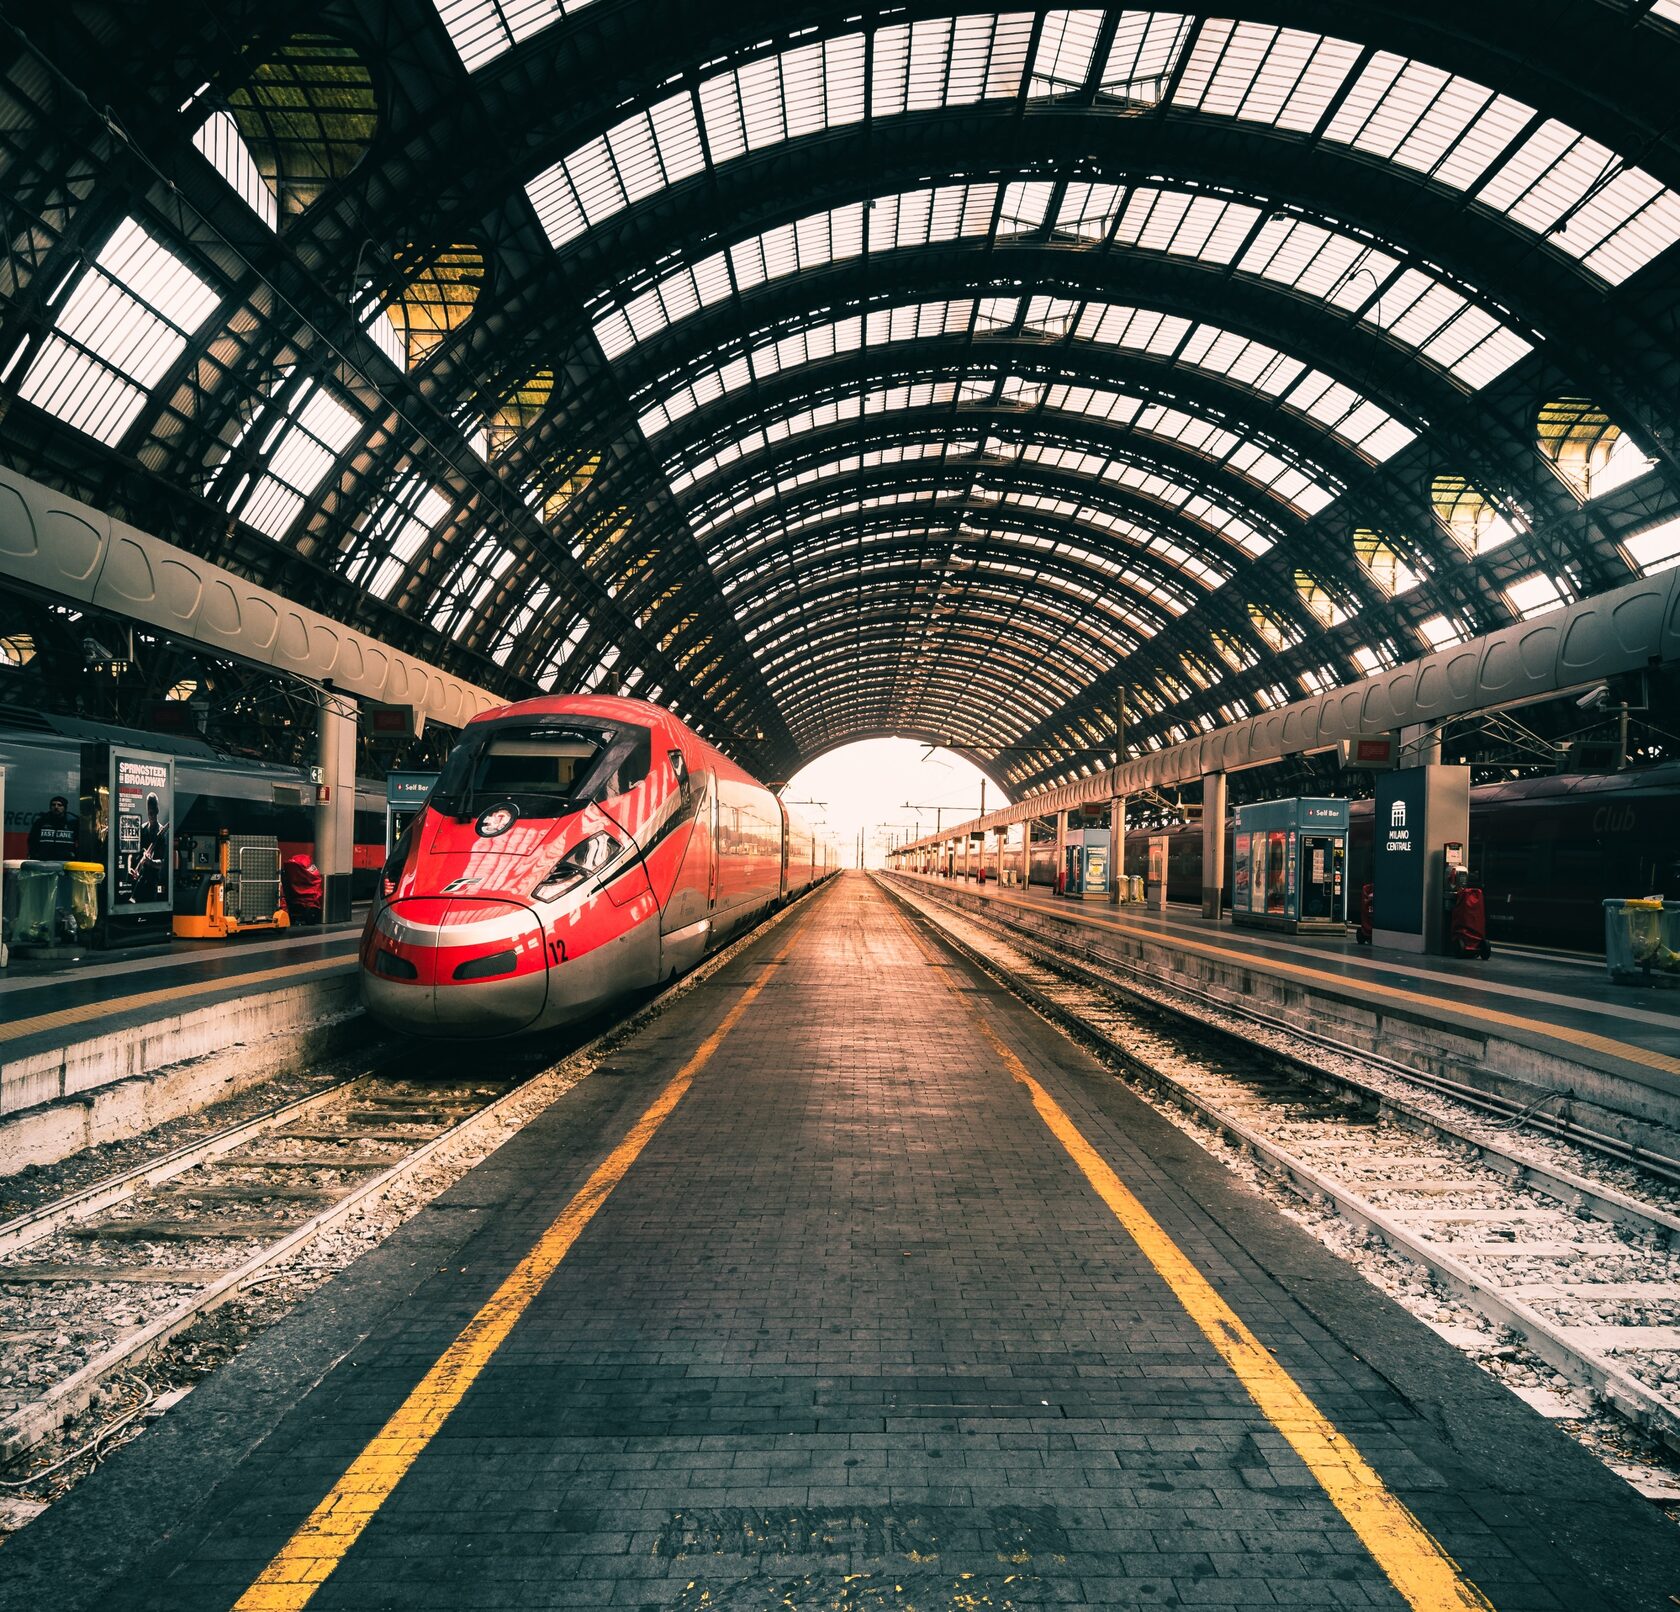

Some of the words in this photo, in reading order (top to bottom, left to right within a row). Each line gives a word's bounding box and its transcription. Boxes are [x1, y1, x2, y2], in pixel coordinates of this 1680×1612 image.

[119, 761, 166, 778] SPRINGSTEEN
[124, 773, 166, 788] BROADWAY
[405, 783, 417, 791] Self
[1316, 809, 1328, 817] Self
[1592, 804, 1636, 832] Club
[1388, 830, 1410, 840] MILANO
[1386, 841, 1412, 851] CENTRALE
[548, 939, 569, 965] 12
